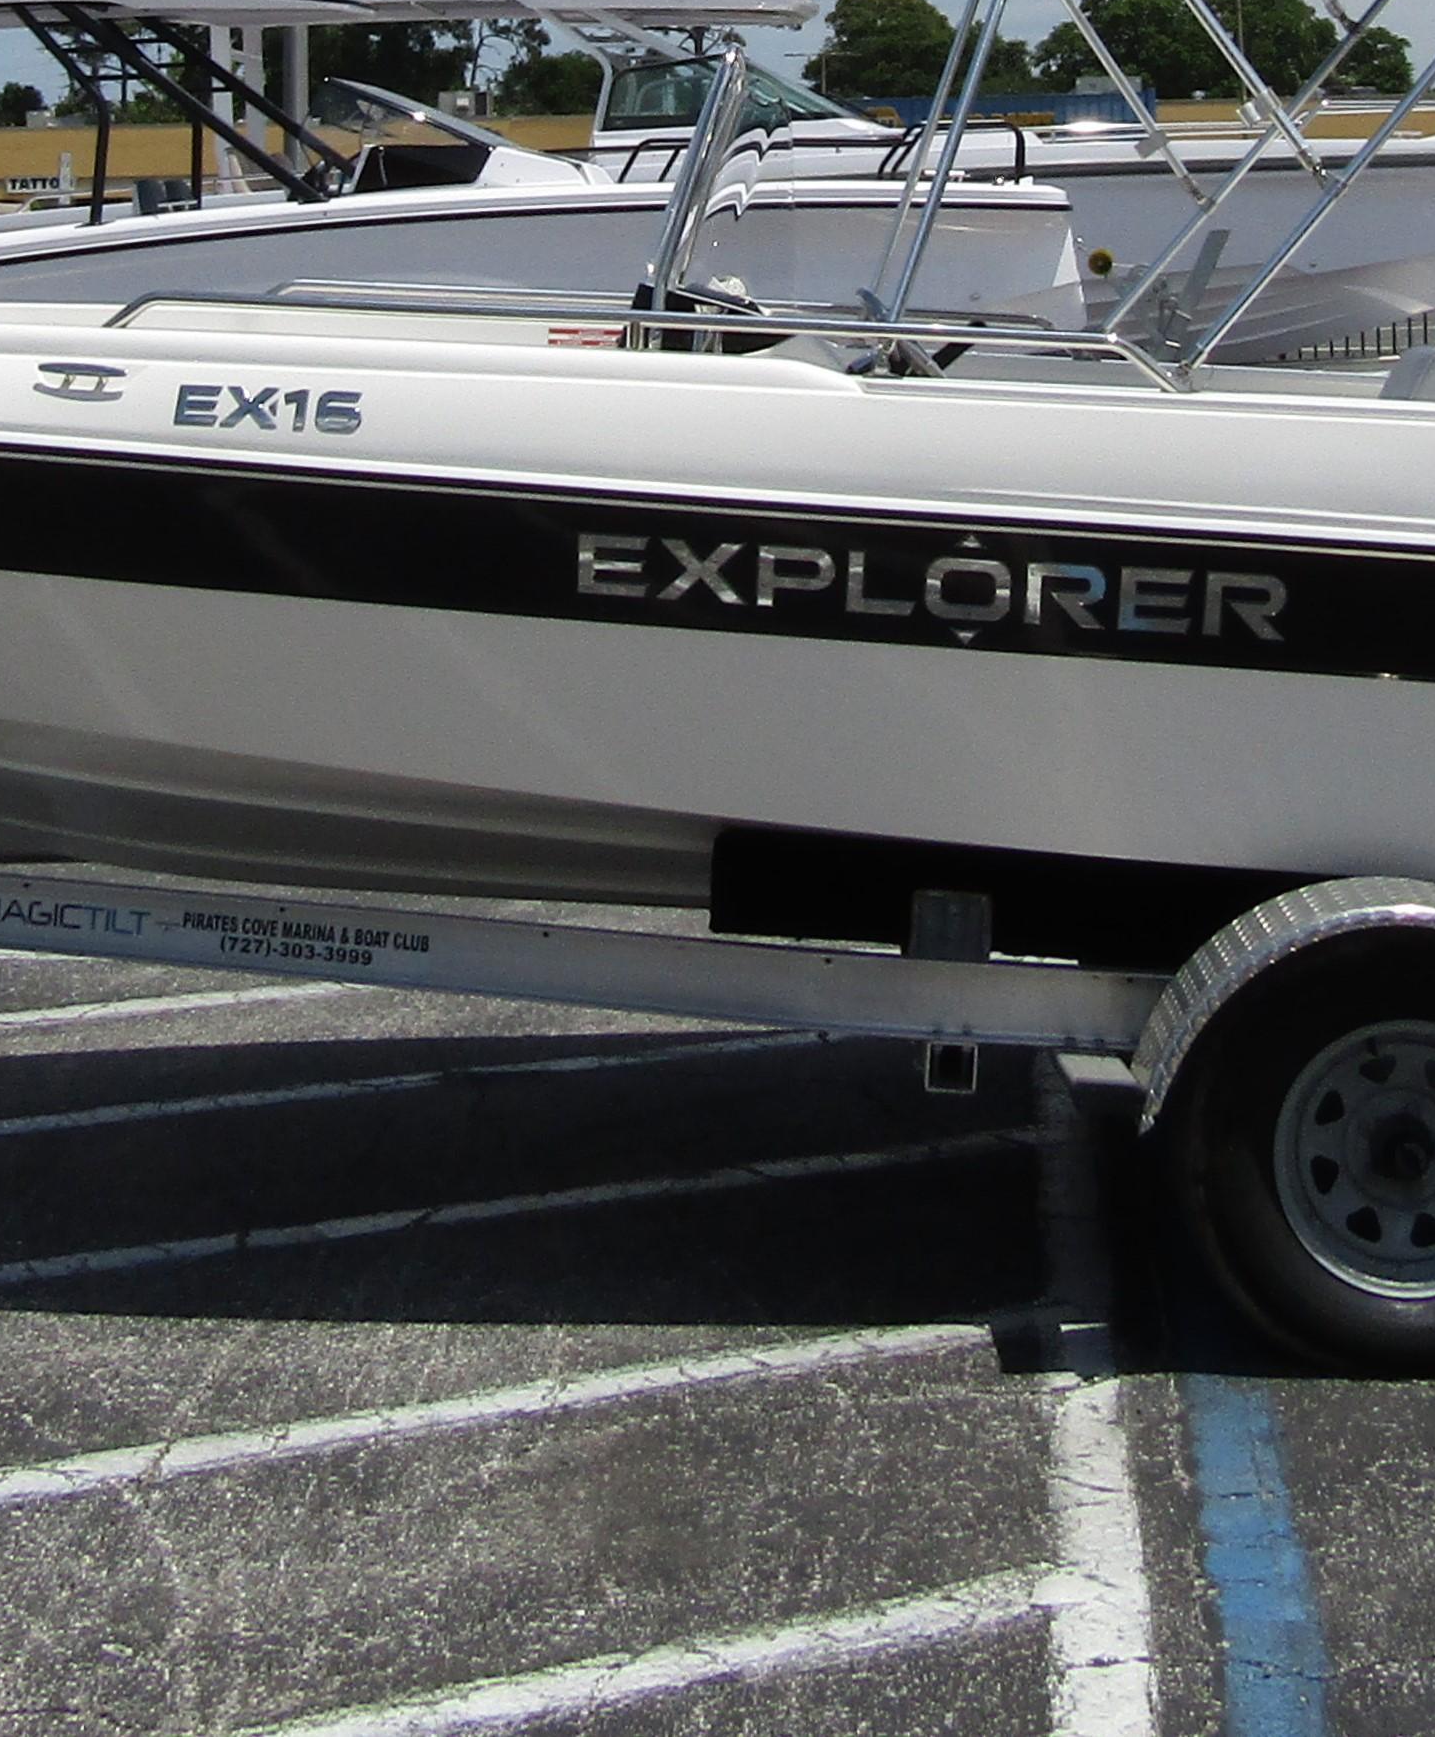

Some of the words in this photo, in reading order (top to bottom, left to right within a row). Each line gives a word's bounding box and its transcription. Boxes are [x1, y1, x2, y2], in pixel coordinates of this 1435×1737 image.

[8, 177, 74, 190] TATTO
[173, 384, 363, 435] EX16
[576, 532, 1288, 641] EXPLORER
[182, 912, 238, 934] PIRATES
[242, 917, 278, 937] COVE
[281, 921, 335, 944] MARINA
[340, 926, 350, 945] &
[354, 928, 390, 948] BOAT
[393, 932, 431, 953] CLUB
[220, 935, 374, 966] (727)-303-3999
